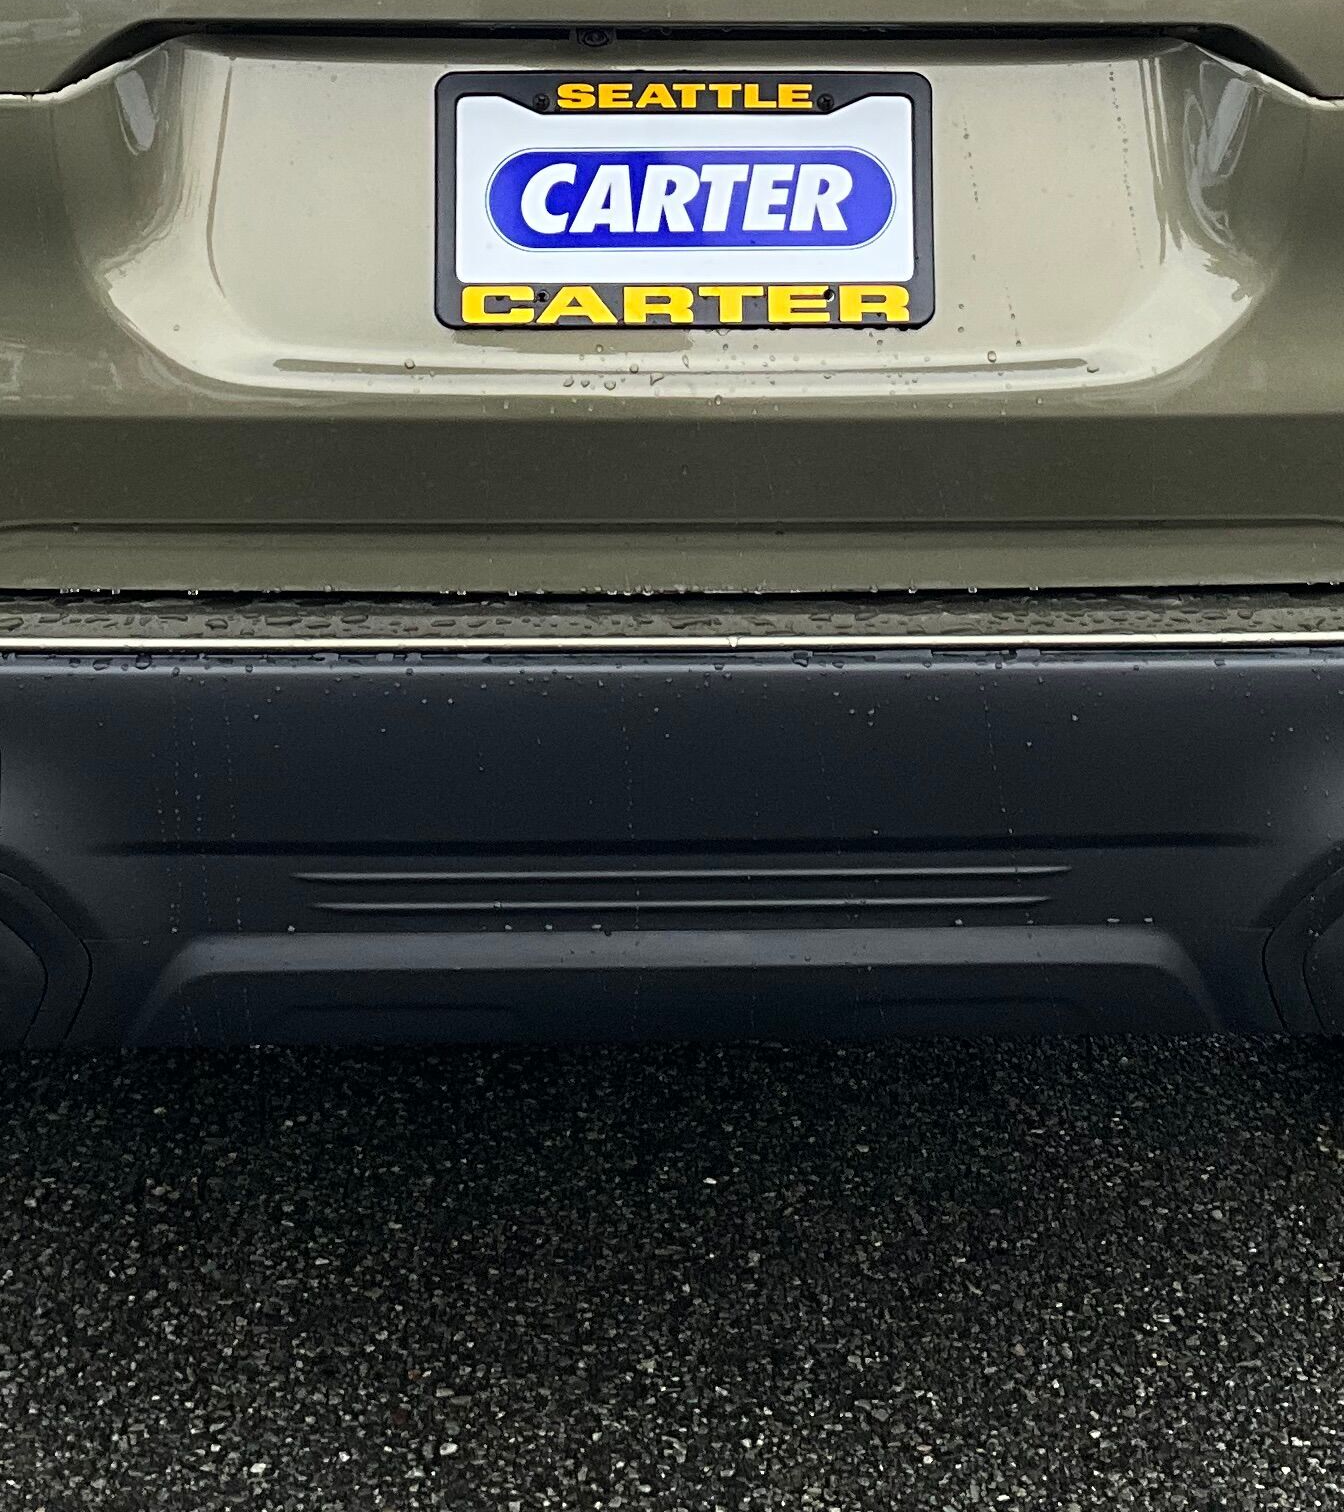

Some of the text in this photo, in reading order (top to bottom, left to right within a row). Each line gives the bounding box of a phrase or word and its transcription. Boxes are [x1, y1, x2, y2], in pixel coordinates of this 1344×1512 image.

[556, 82, 814, 110] SEATTLE
[520, 162, 854, 235] CARTER
[460, 284, 911, 325] CARTER
